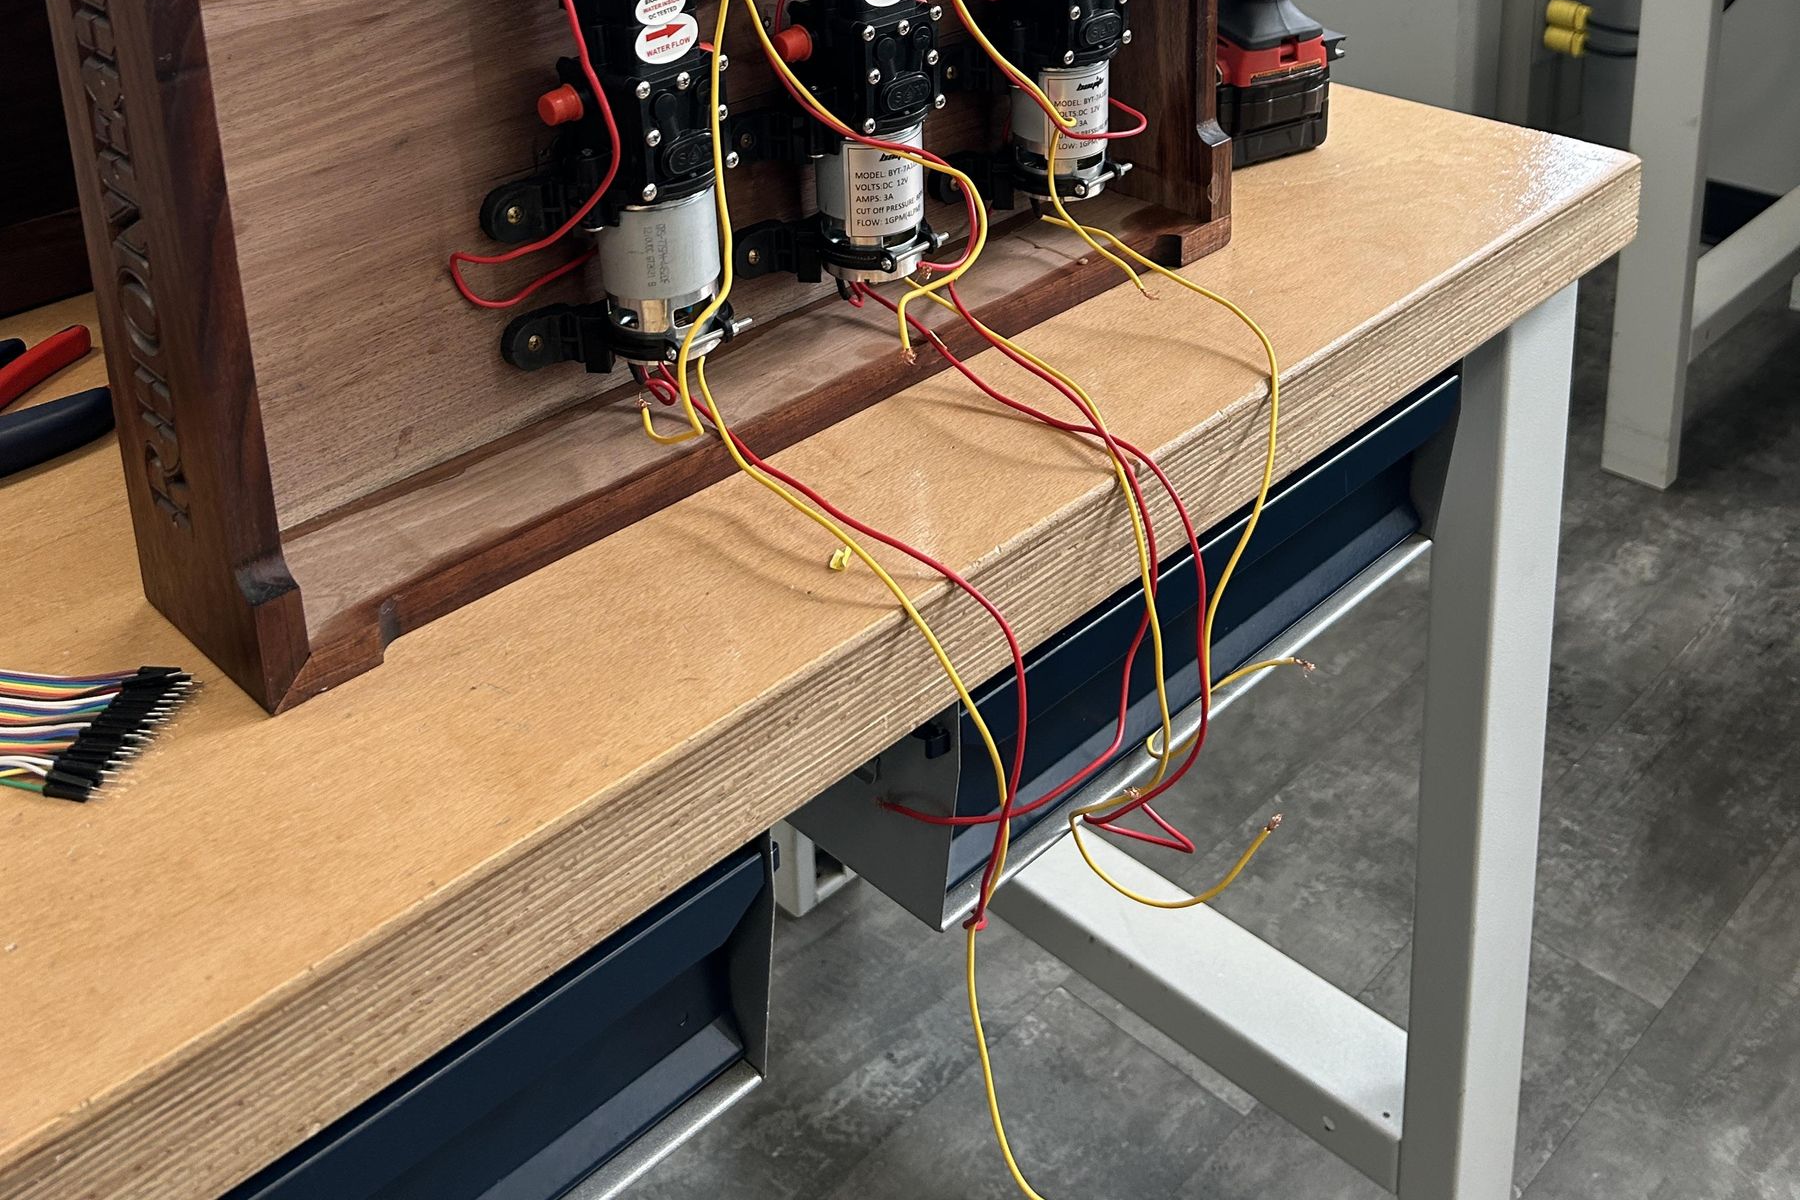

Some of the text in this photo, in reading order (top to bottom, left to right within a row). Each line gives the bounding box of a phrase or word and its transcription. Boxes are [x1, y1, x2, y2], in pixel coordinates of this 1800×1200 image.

[644, 3, 662, 13] WATER
[657, 6, 677, 16] TESTED
[647, 37, 690, 57] WATER FLOW
[1059, 109, 1088, 117] OLTS:DC
[897, 177, 908, 186] 12V
[884, 193, 894, 202] 3A
